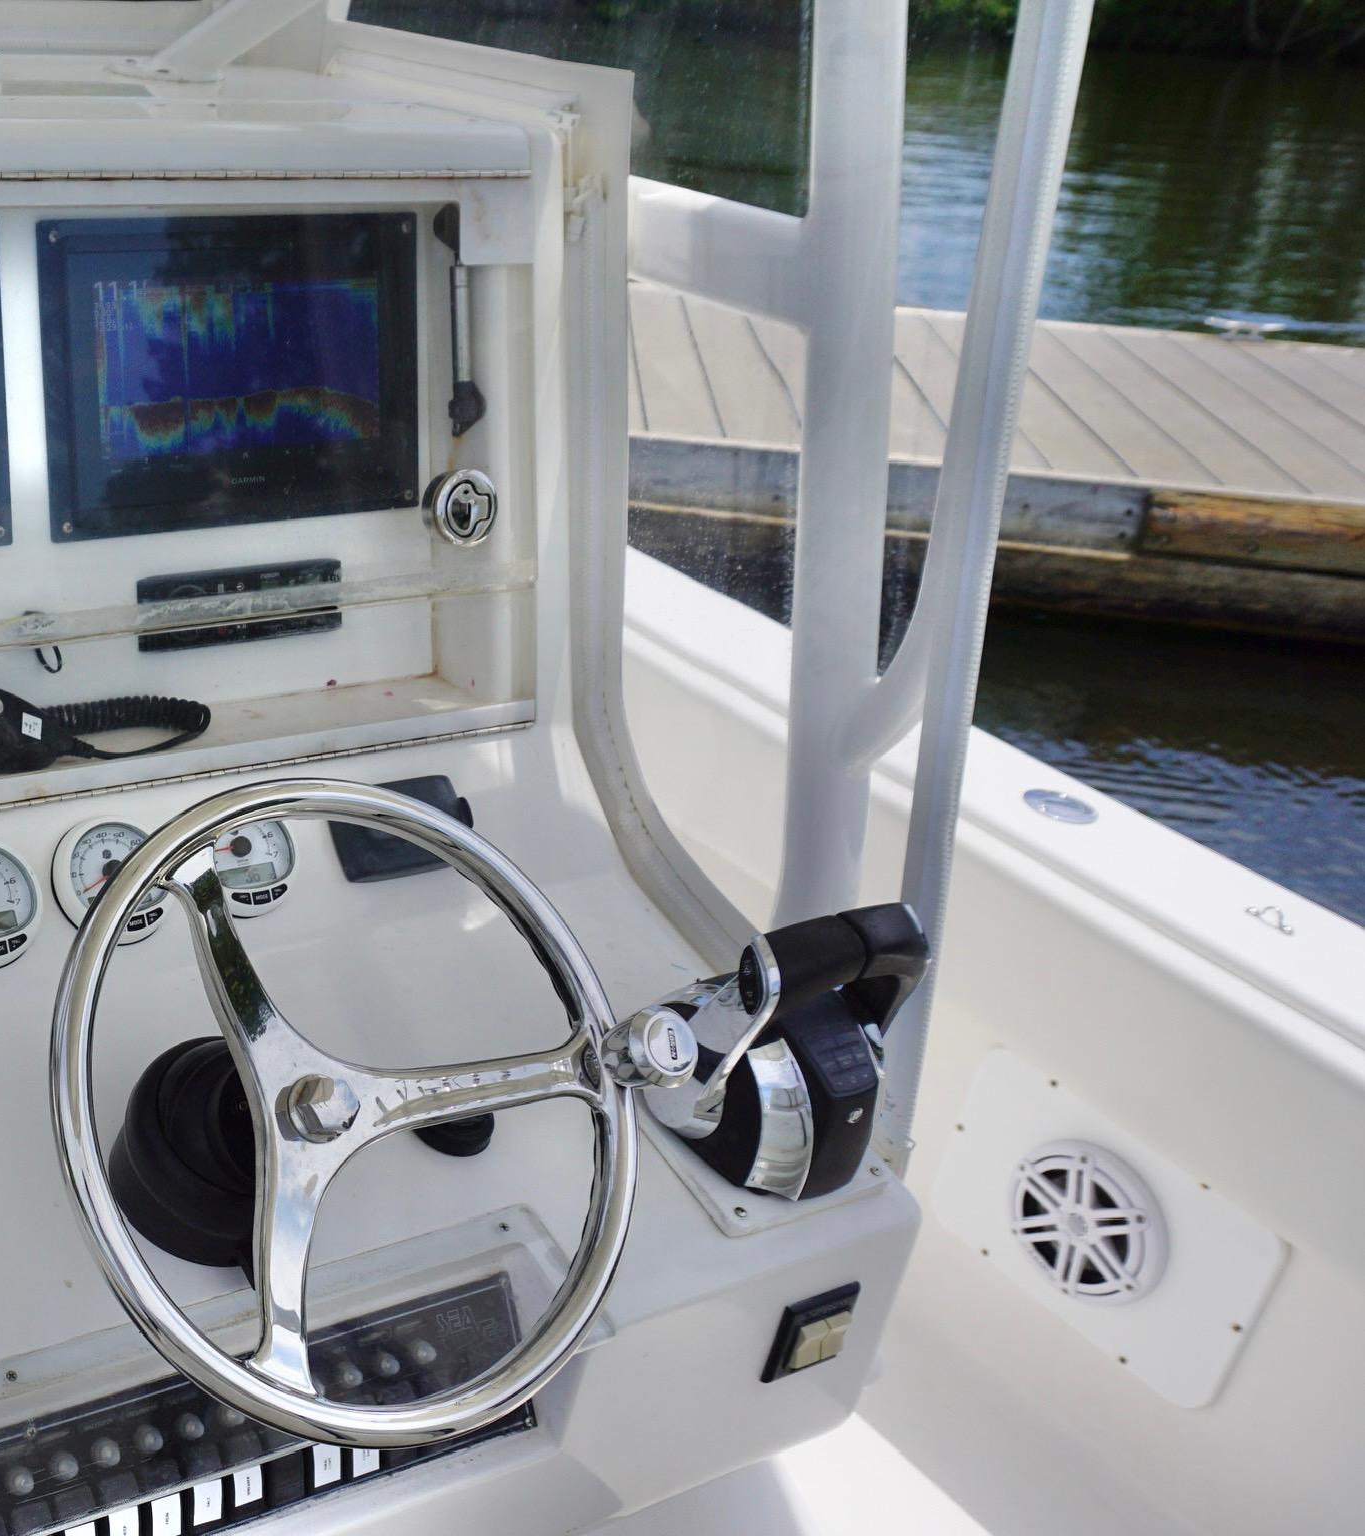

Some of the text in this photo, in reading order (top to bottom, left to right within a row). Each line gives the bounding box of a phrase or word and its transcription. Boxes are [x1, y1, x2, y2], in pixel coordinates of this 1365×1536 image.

[231, 476, 266, 485] GARMIN
[267, 831, 274, 839] 6
[9, 877, 17, 885] 6
[129, 919, 144, 927] MODE
